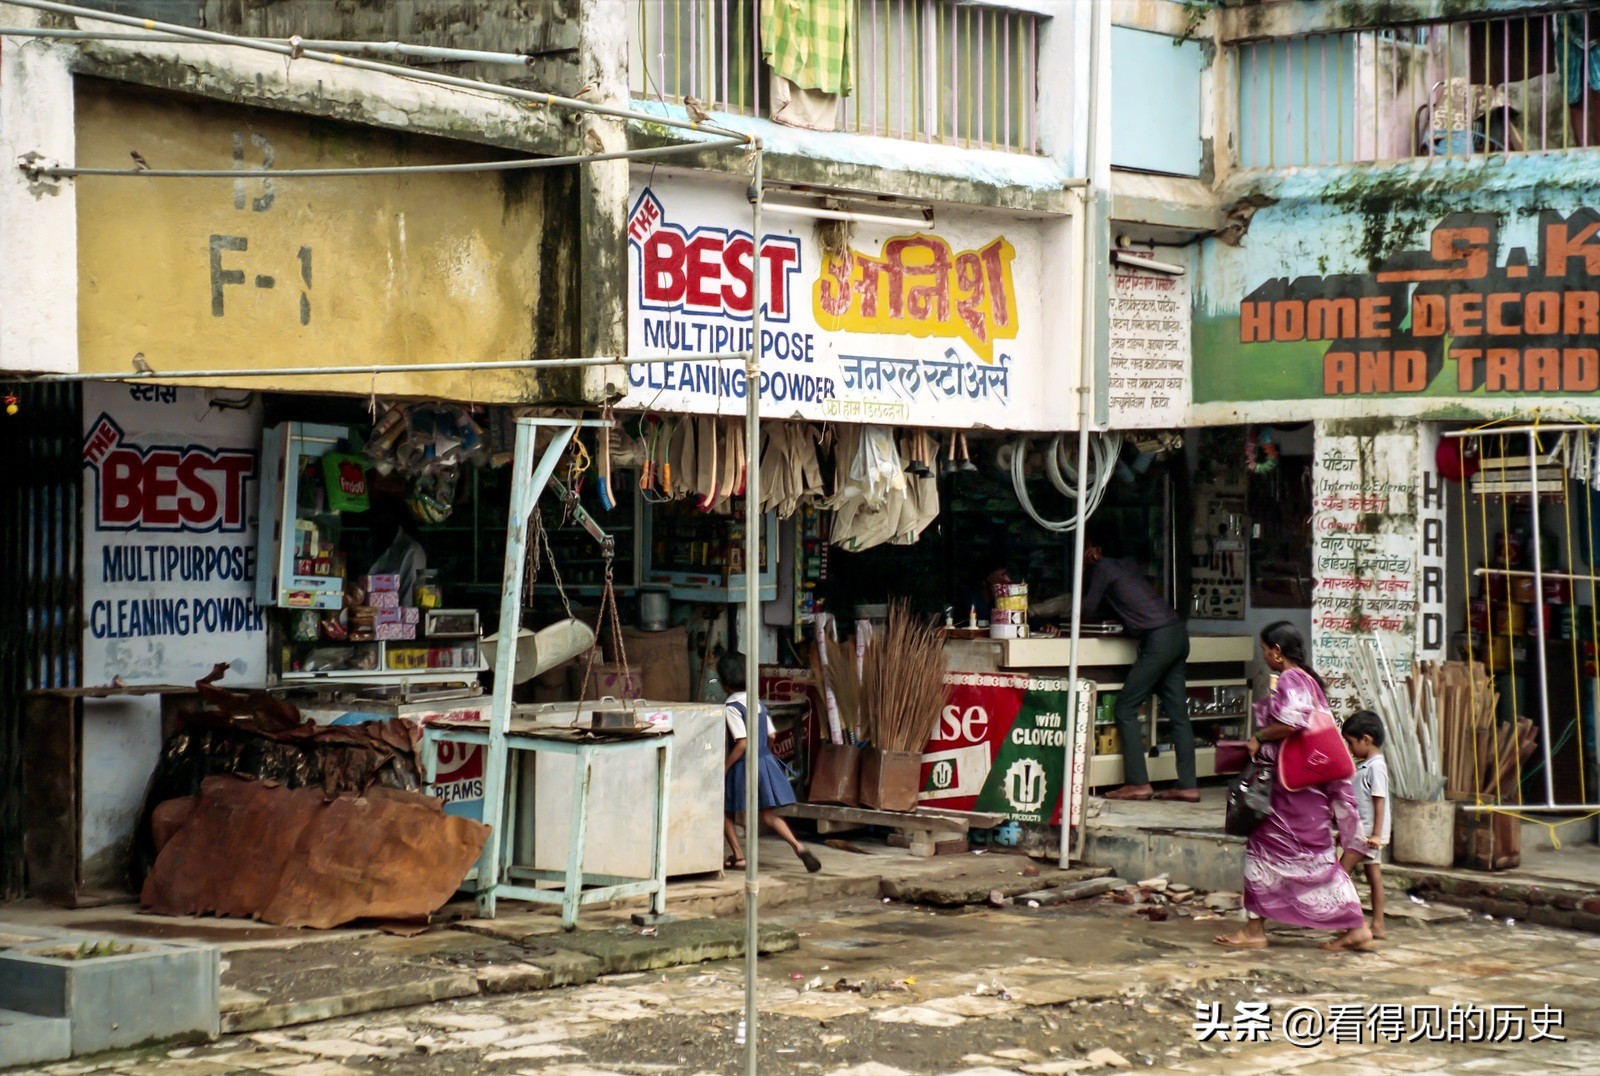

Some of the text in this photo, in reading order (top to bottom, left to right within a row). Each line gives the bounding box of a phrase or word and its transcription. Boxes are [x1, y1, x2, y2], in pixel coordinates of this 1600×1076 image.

[628, 198, 659, 241] THE
[210, 234, 312, 326] F-1
[643, 230, 796, 314] BEST
[1240, 290, 1600, 344] HOME DECOR
[628, 362, 835, 404] CLEANING POWDER
[838, 354, 920, 401] जनरल
[1323, 347, 1600, 395] AND TRAD
[83, 421, 117, 463] THE
[102, 450, 254, 524] BEST
[103, 545, 254, 582] MULTIPURPOSE
[1423, 471, 1443, 651] HARD
[90, 597, 263, 639] CLEANING POWDER
[1012, 727, 1068, 747] CLOVEO
[1035, 712, 1061, 727] with
